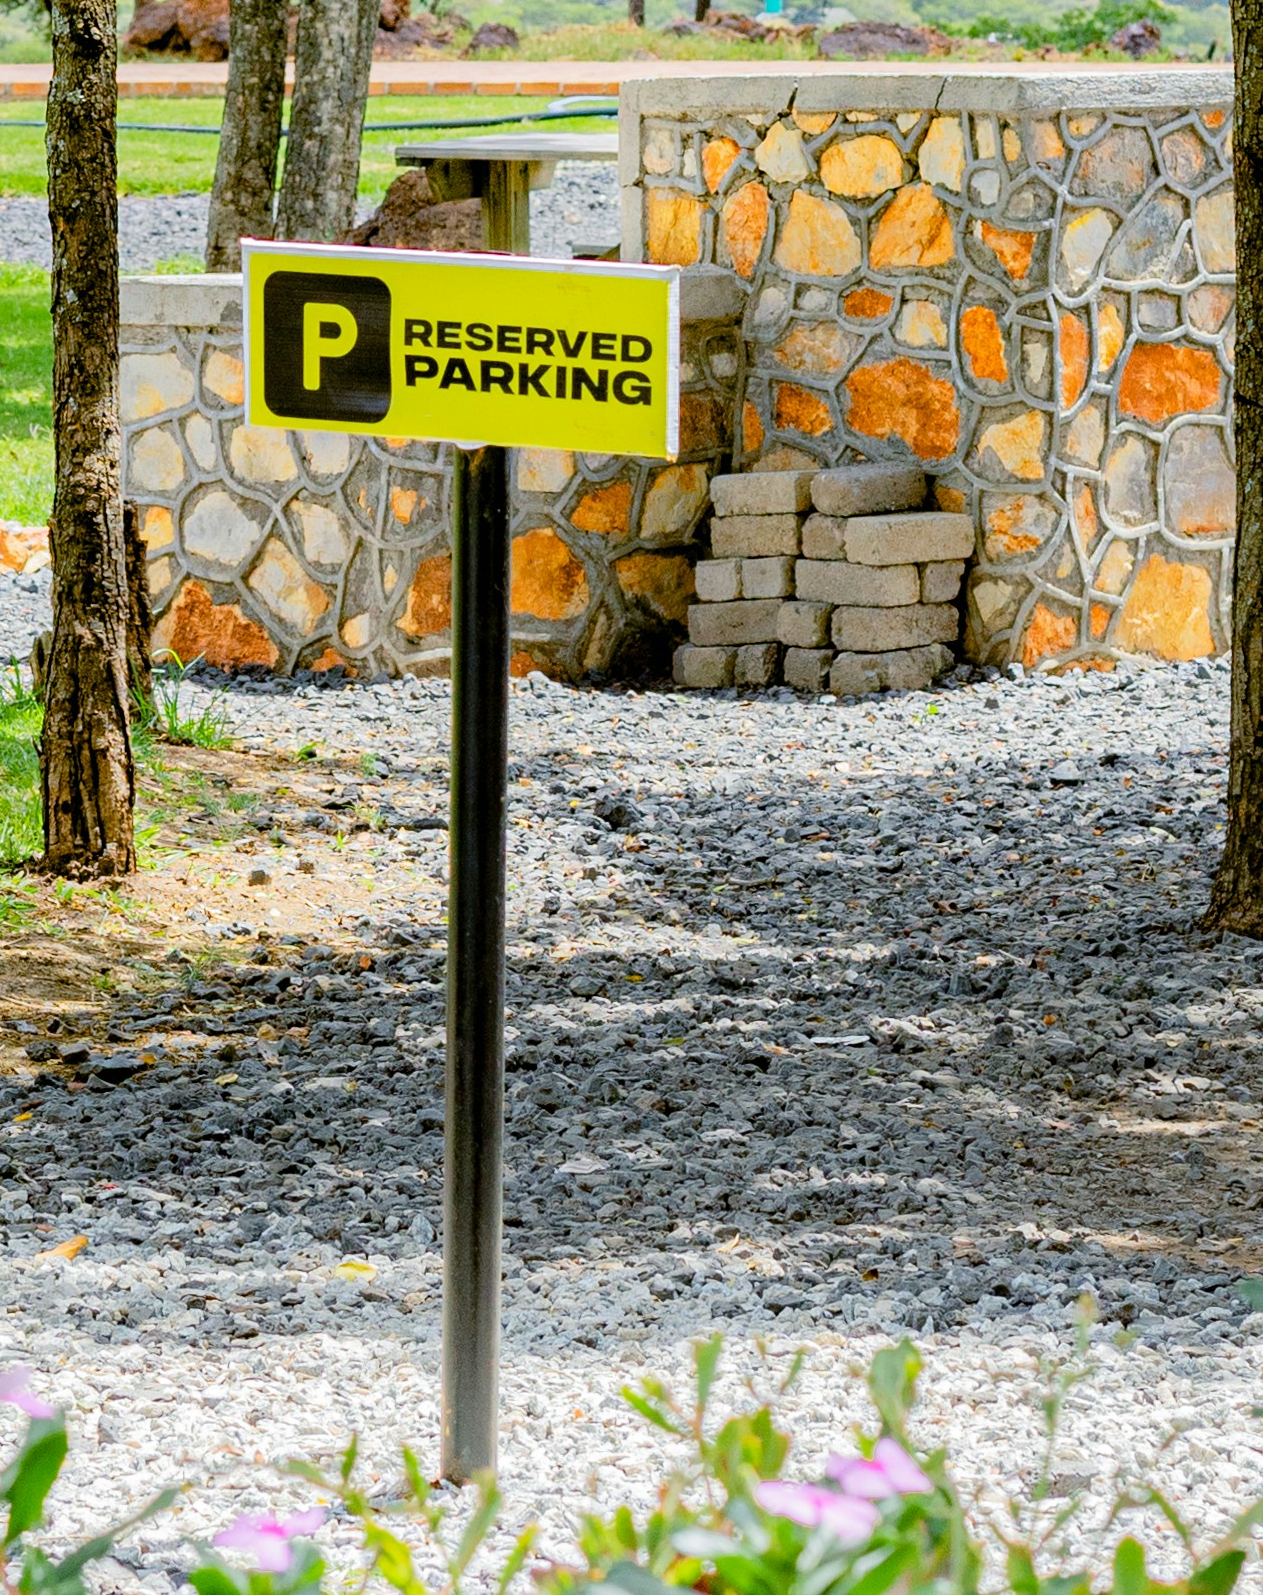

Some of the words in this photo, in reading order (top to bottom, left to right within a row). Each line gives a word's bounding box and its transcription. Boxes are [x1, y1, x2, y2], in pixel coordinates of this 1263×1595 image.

[303, 302, 358, 391] P
[404, 318, 653, 363] RESERVED
[404, 354, 653, 406] PARKING
